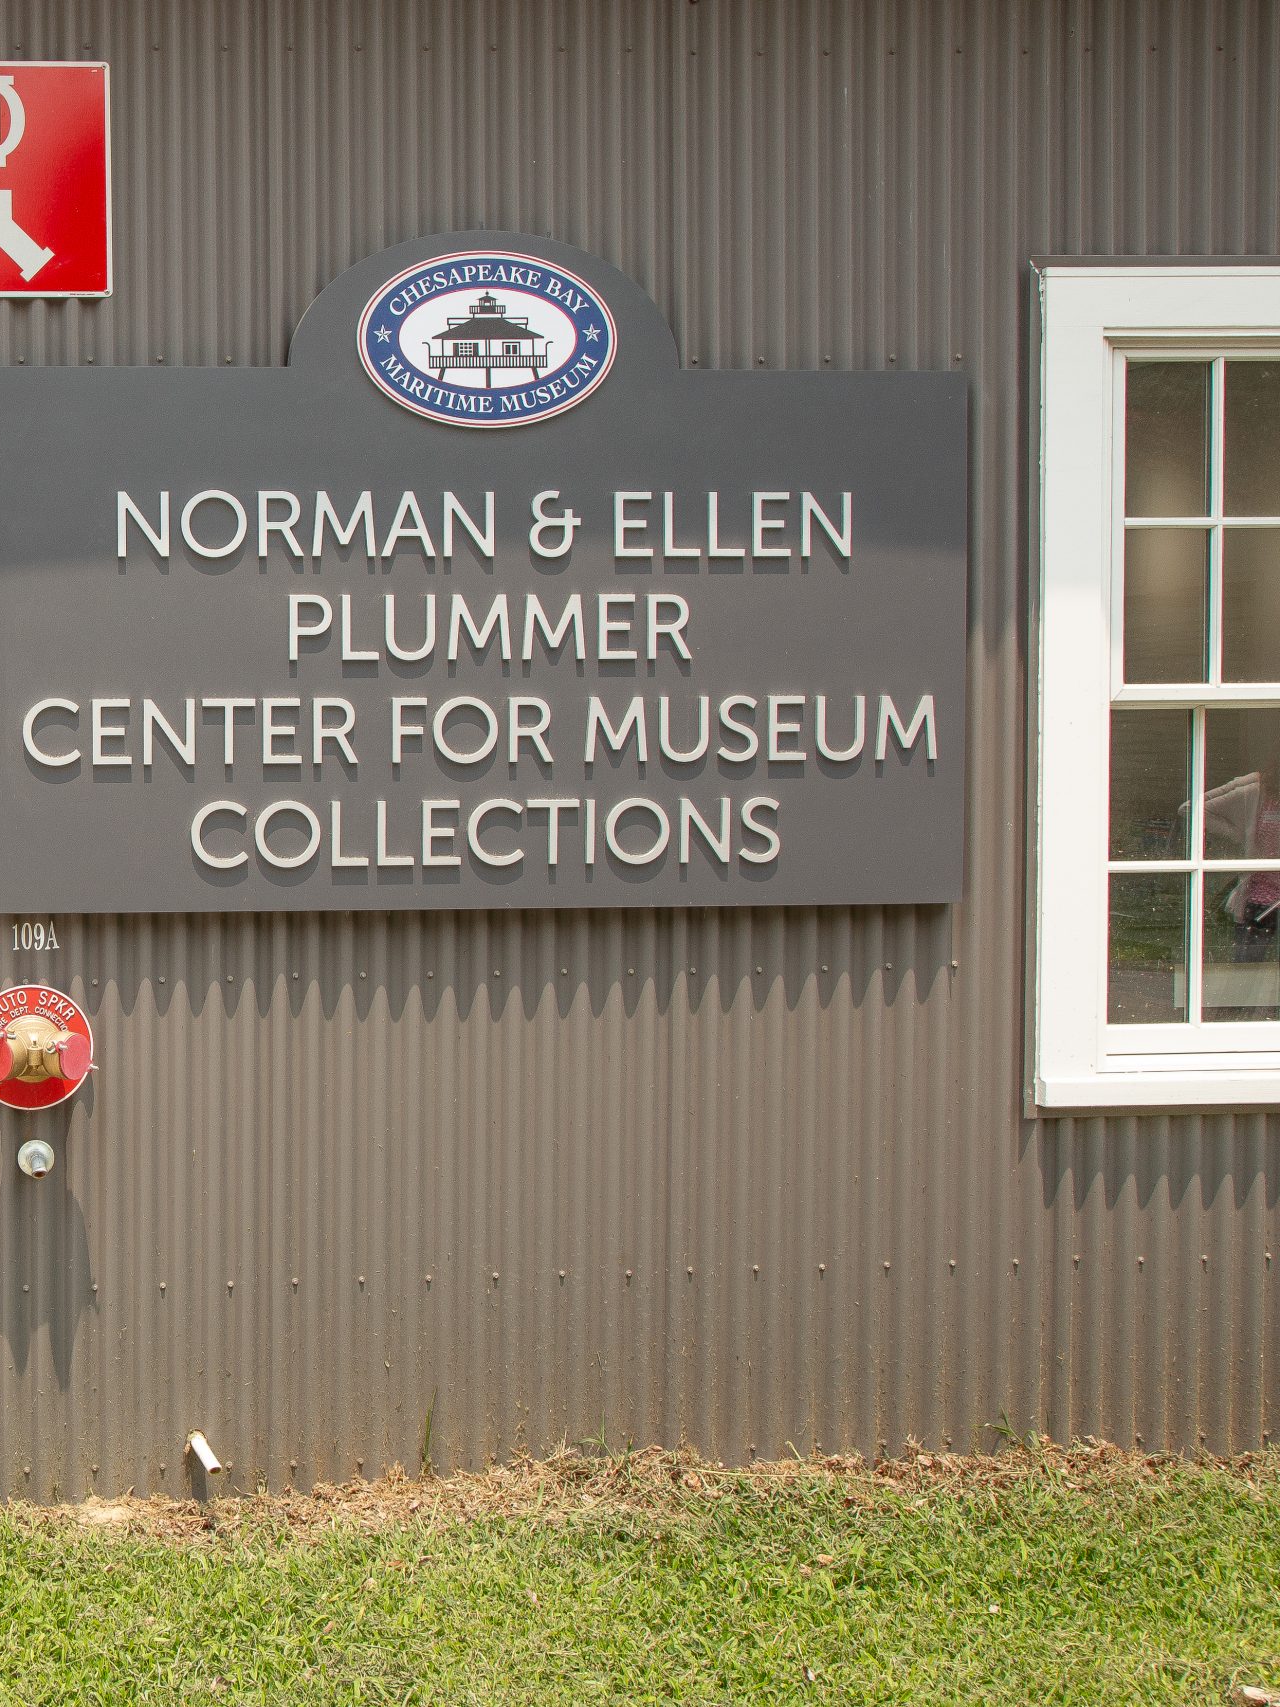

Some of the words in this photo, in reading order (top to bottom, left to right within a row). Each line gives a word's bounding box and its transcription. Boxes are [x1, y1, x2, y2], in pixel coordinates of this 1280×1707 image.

[389, 264, 542, 317] CHESAPEAKE
[544, 277, 590, 316] BAY
[379, 353, 494, 414] MARITIME
[500, 352, 599, 414] MUSEUM
[117, 489, 495, 558] NORMAN
[528, 490, 582, 558] &
[614, 491, 852, 557] ELLEN
[289, 593, 692, 661] PLUMMER
[22, 697, 359, 767] CENTER
[391, 696, 553, 764] FOR
[584, 695, 938, 763] MUSEUM
[190, 796, 781, 869] COLLECTIONS
[12, 920, 60, 952] 109A
[38, 991, 76, 1021] SPKR
